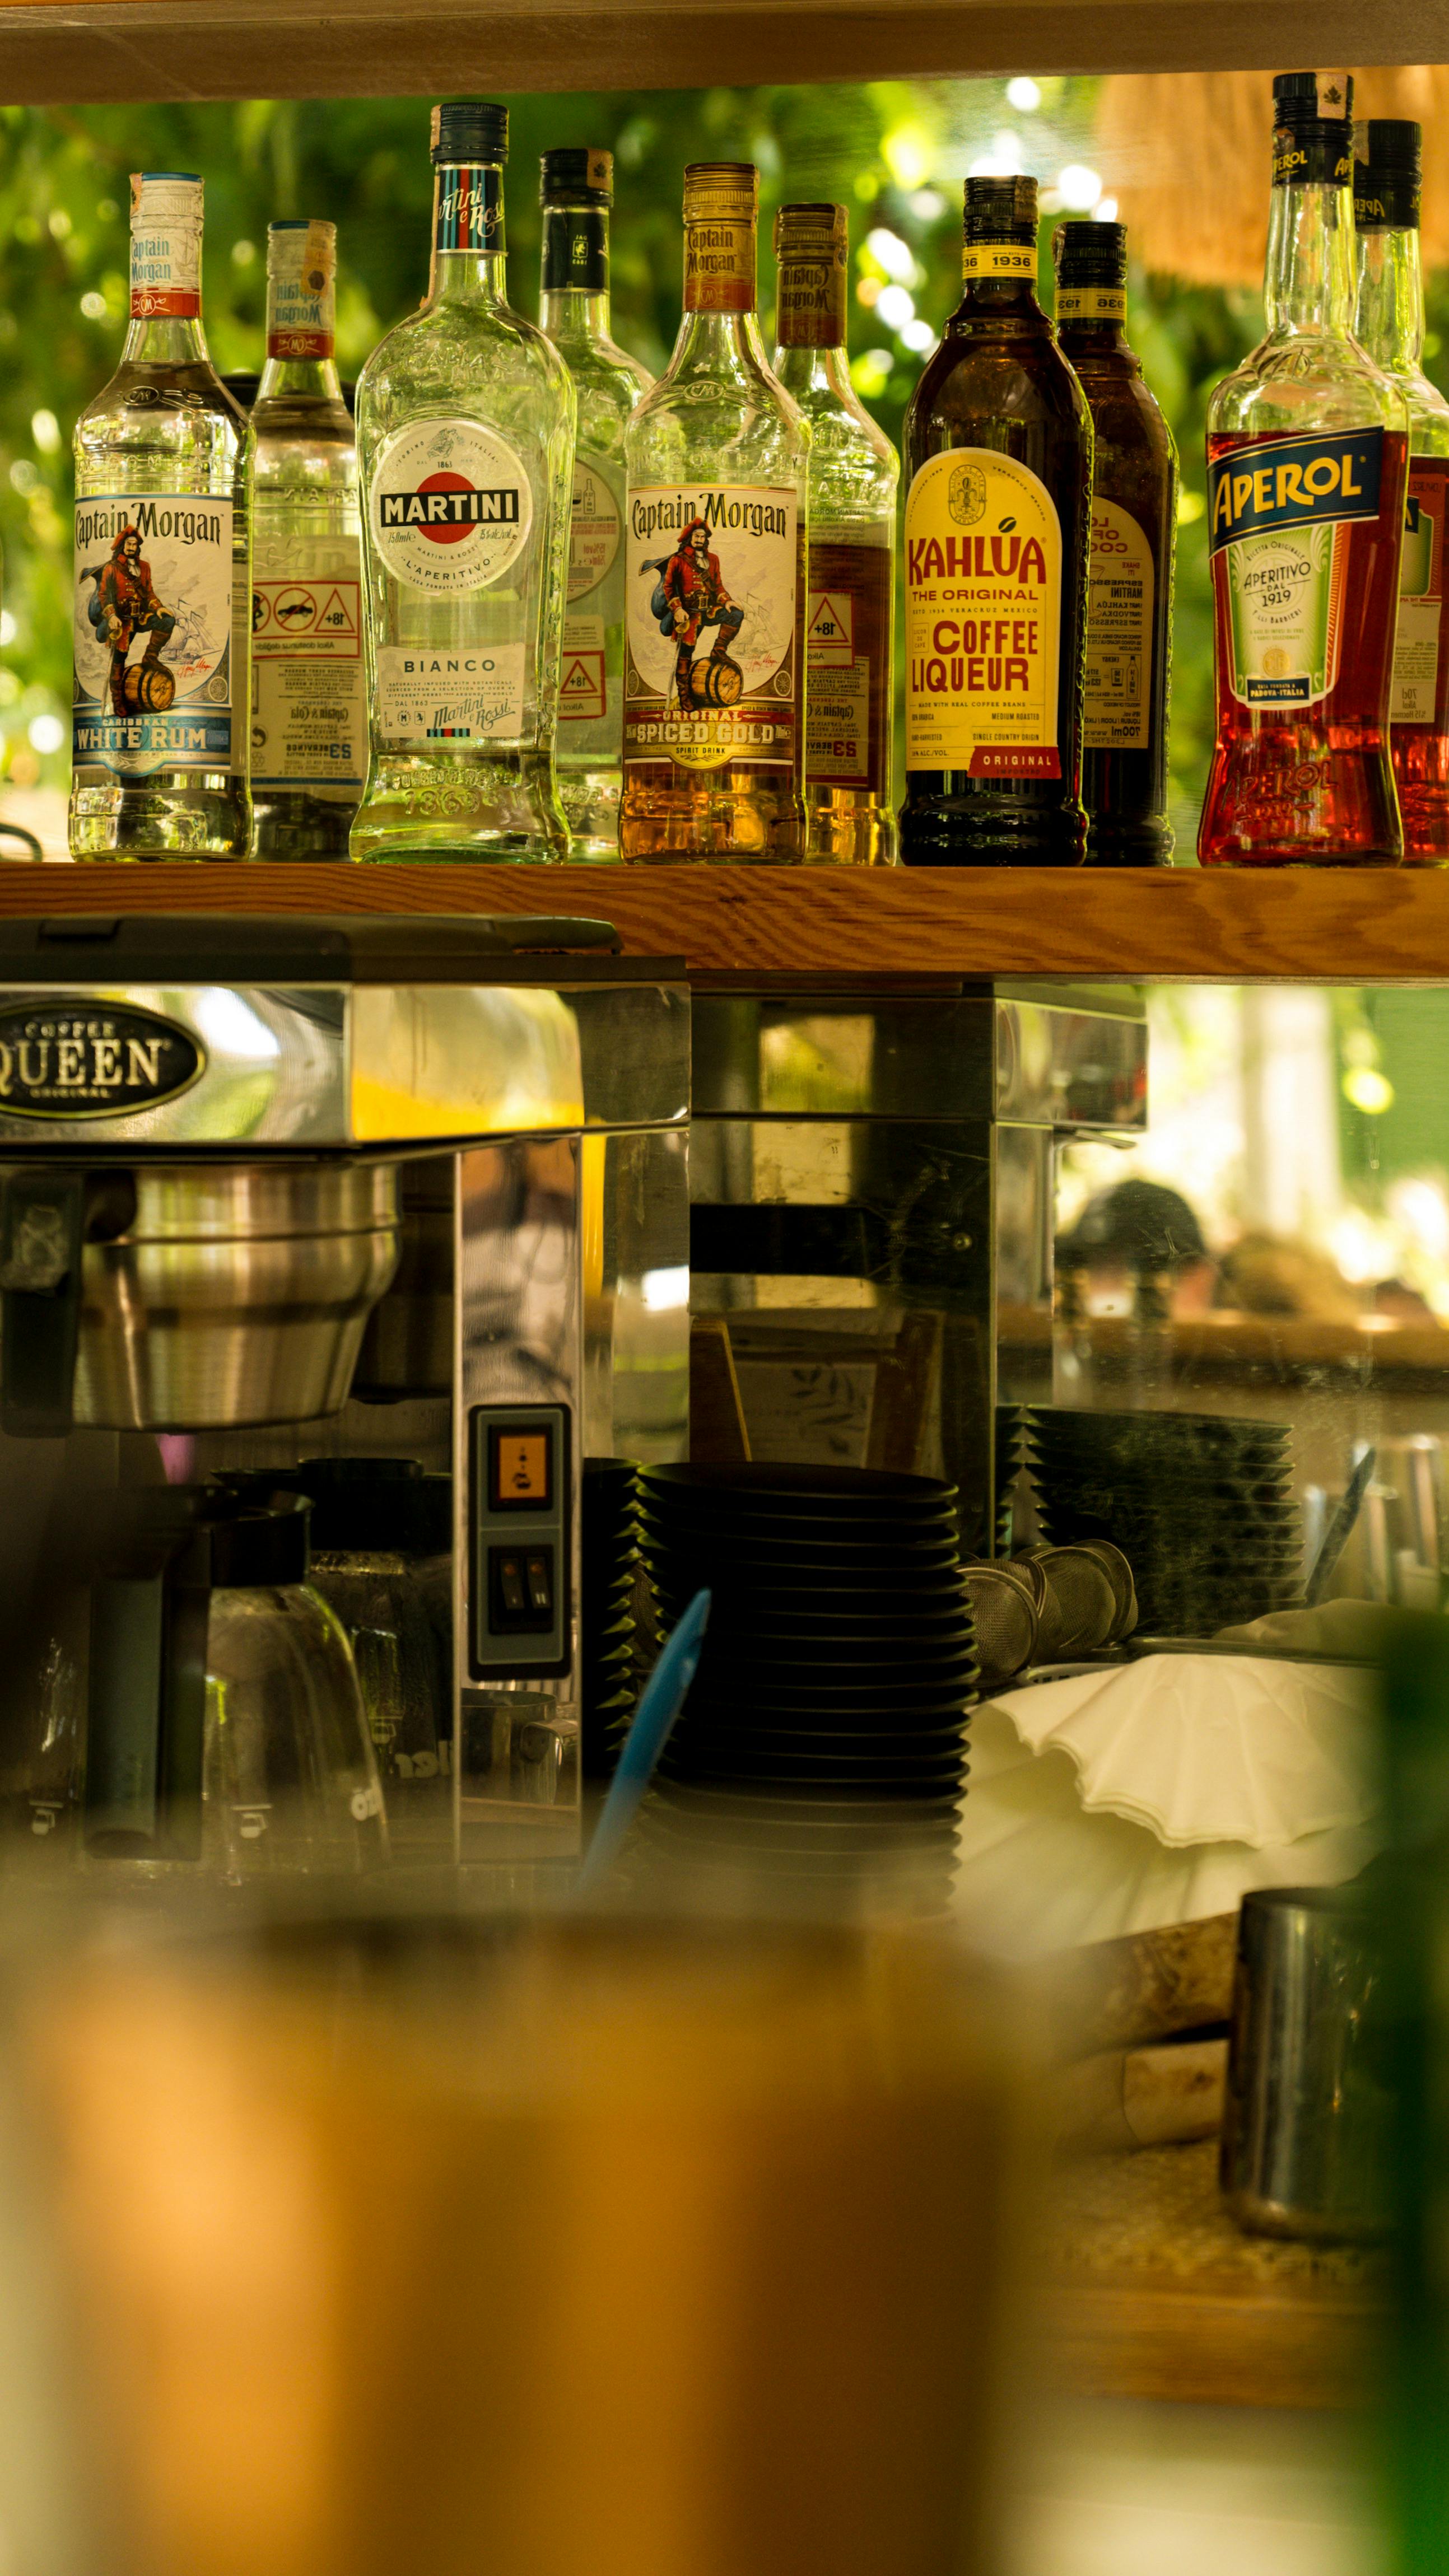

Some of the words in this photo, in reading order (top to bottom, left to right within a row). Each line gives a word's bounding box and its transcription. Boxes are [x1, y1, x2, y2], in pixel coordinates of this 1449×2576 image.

[1273, 150, 1308, 174] PEROL
[132, 236, 169, 261] Captain
[688, 226, 734, 252] Captain
[132, 262, 171, 282] Morgan
[687, 254, 736, 278] Morgan
[963, 257, 978, 268] 36
[992, 256, 1031, 268] 1936
[1213, 454, 1362, 535] APEROL
[384, 493, 514, 524] MARTINI
[632, 493, 696, 541] Captain
[698, 493, 787, 540] Morgan
[76, 503, 128, 550] Captain
[131, 503, 221, 547] Morgan
[416, 545, 447, 561] MARTINI
[406, 557, 491, 581] L'APERITIVO
[1243, 561, 1312, 590] APERITIVO
[912, 590, 938, 602] THE
[942, 589, 1039, 600] ORIGINAL
[1267, 582, 1286, 592] DAL
[1262, 590, 1292, 608] 1919
[933, 619, 1039, 656] COFFEE
[404, 659, 496, 673] BIANCO
[912, 657, 1029, 693] LIQUEUR
[102, 718, 168, 726] CARIBBEAN
[434, 694, 484, 730] Martini
[476, 698, 516, 731] Rossi
[663, 710, 743, 722] ORIGINAL
[1015, 713, 1040, 721] ROASTED
[77, 727, 143, 749] WHITE
[150, 727, 207, 749] RUM
[637, 722, 709, 744] SPICED
[716, 723, 775, 745] GOLD
[972, 733, 993, 741] SINGLE
[994, 733, 1019, 741] COUNTRY
[1021, 733, 1040, 741] ORIGIN
[982, 755, 1052, 766] ORIGINAL
[24, 1021, 117, 1039] COFFEE
